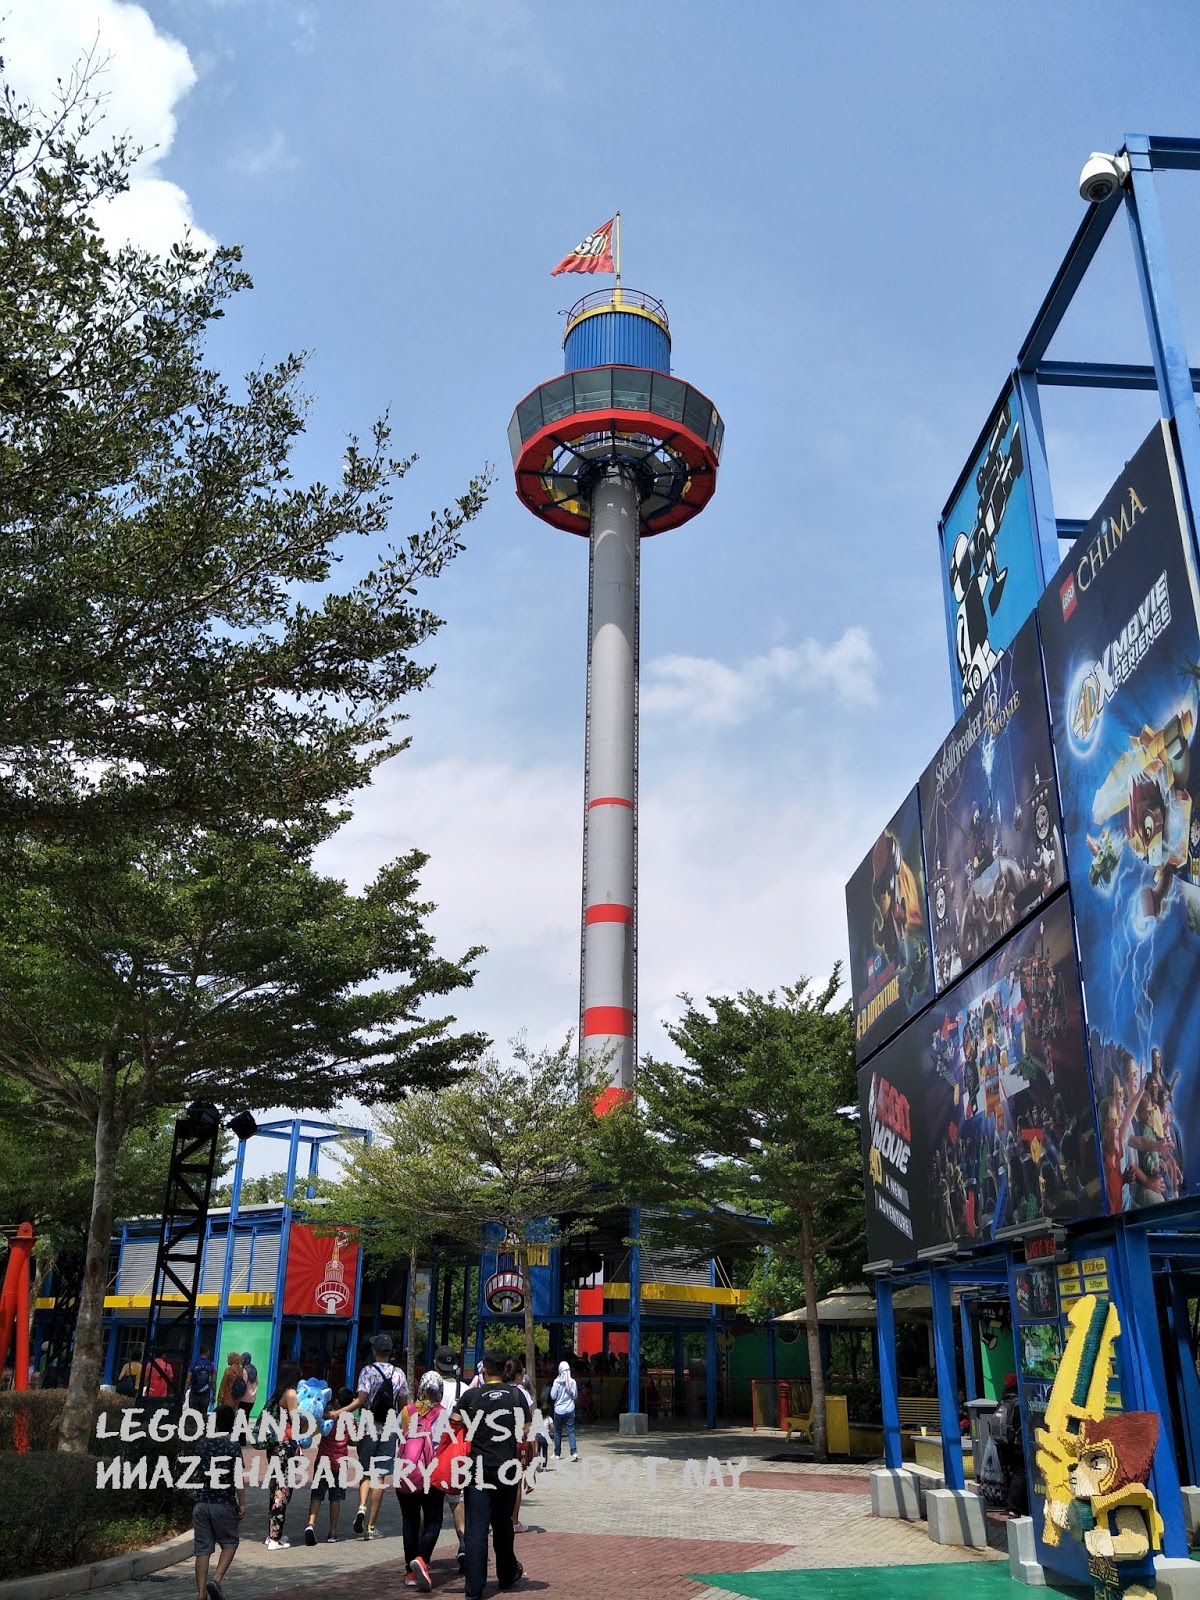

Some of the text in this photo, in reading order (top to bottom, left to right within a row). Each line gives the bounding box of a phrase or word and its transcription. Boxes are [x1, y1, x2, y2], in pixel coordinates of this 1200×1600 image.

[1077, 487, 1147, 591] CHIMA
[1112, 570, 1168, 668] MOVIE
[988, 690, 1020, 738] MOVIE
[935, 711, 982, 794] Spellbreaker
[872, 1120, 911, 1175] MOVIE
[879, 1195, 910, 1235] ADVENTURE
